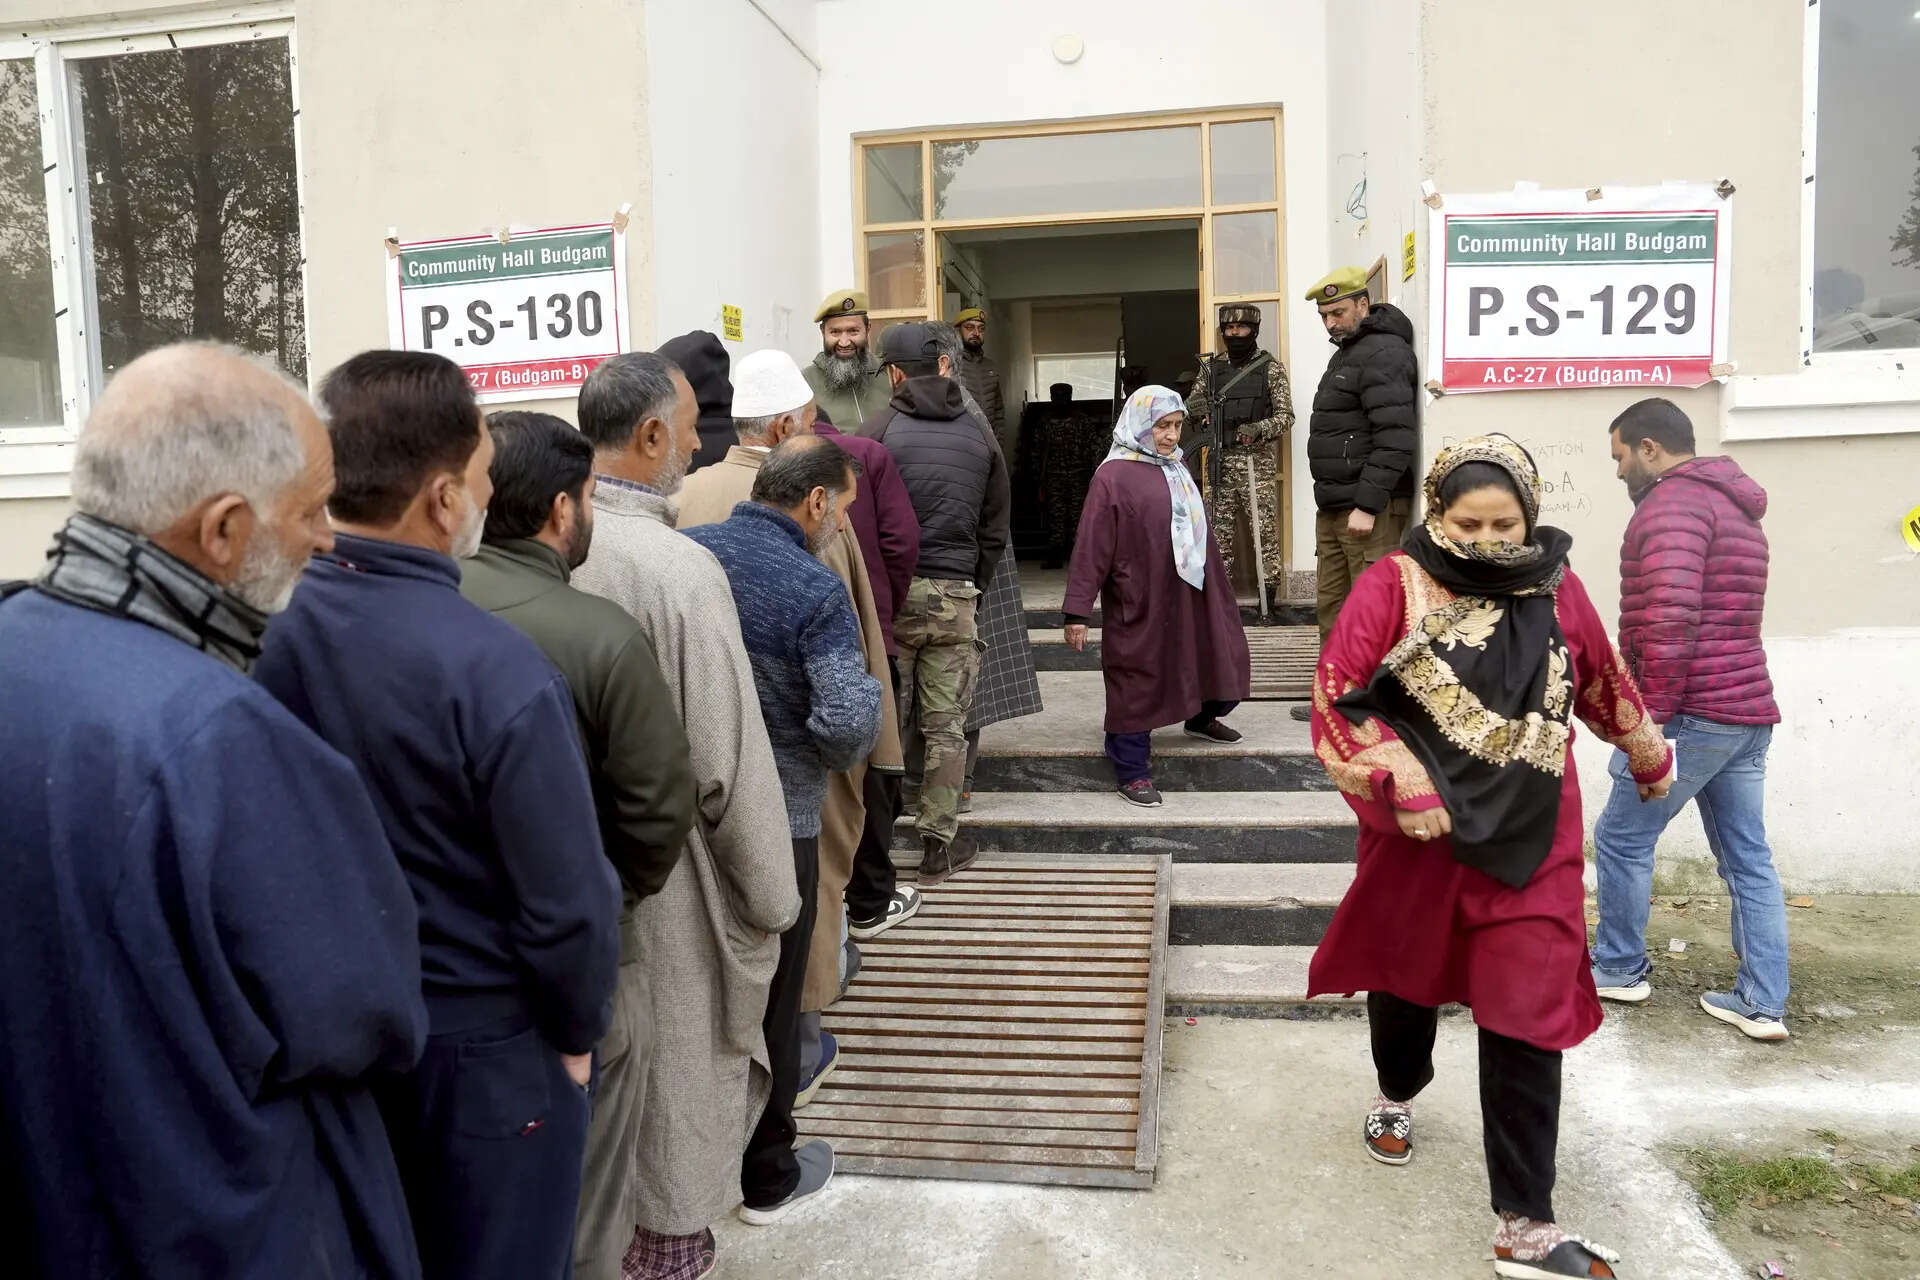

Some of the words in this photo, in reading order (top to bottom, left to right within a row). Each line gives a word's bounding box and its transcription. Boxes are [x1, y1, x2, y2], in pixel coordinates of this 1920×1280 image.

[1457, 233, 1568, 255] Community
[1576, 232, 1616, 251] Hall
[1625, 232, 1707, 254] Budgam
[408, 253, 496, 278] Community
[502, 249, 534, 269] Hall
[541, 244, 607, 266] Budgam
[421, 290, 603, 349] P.S-130
[1468, 283, 1696, 336] P.S-129
[469, 372, 489, 388] 27
[495, 364, 589, 389] (Budgam-B)
[1483, 366, 1548, 384] A.C-27
[1555, 365, 1672, 386] (Budgam-A)
[1520, 439, 1584, 460] TATION
